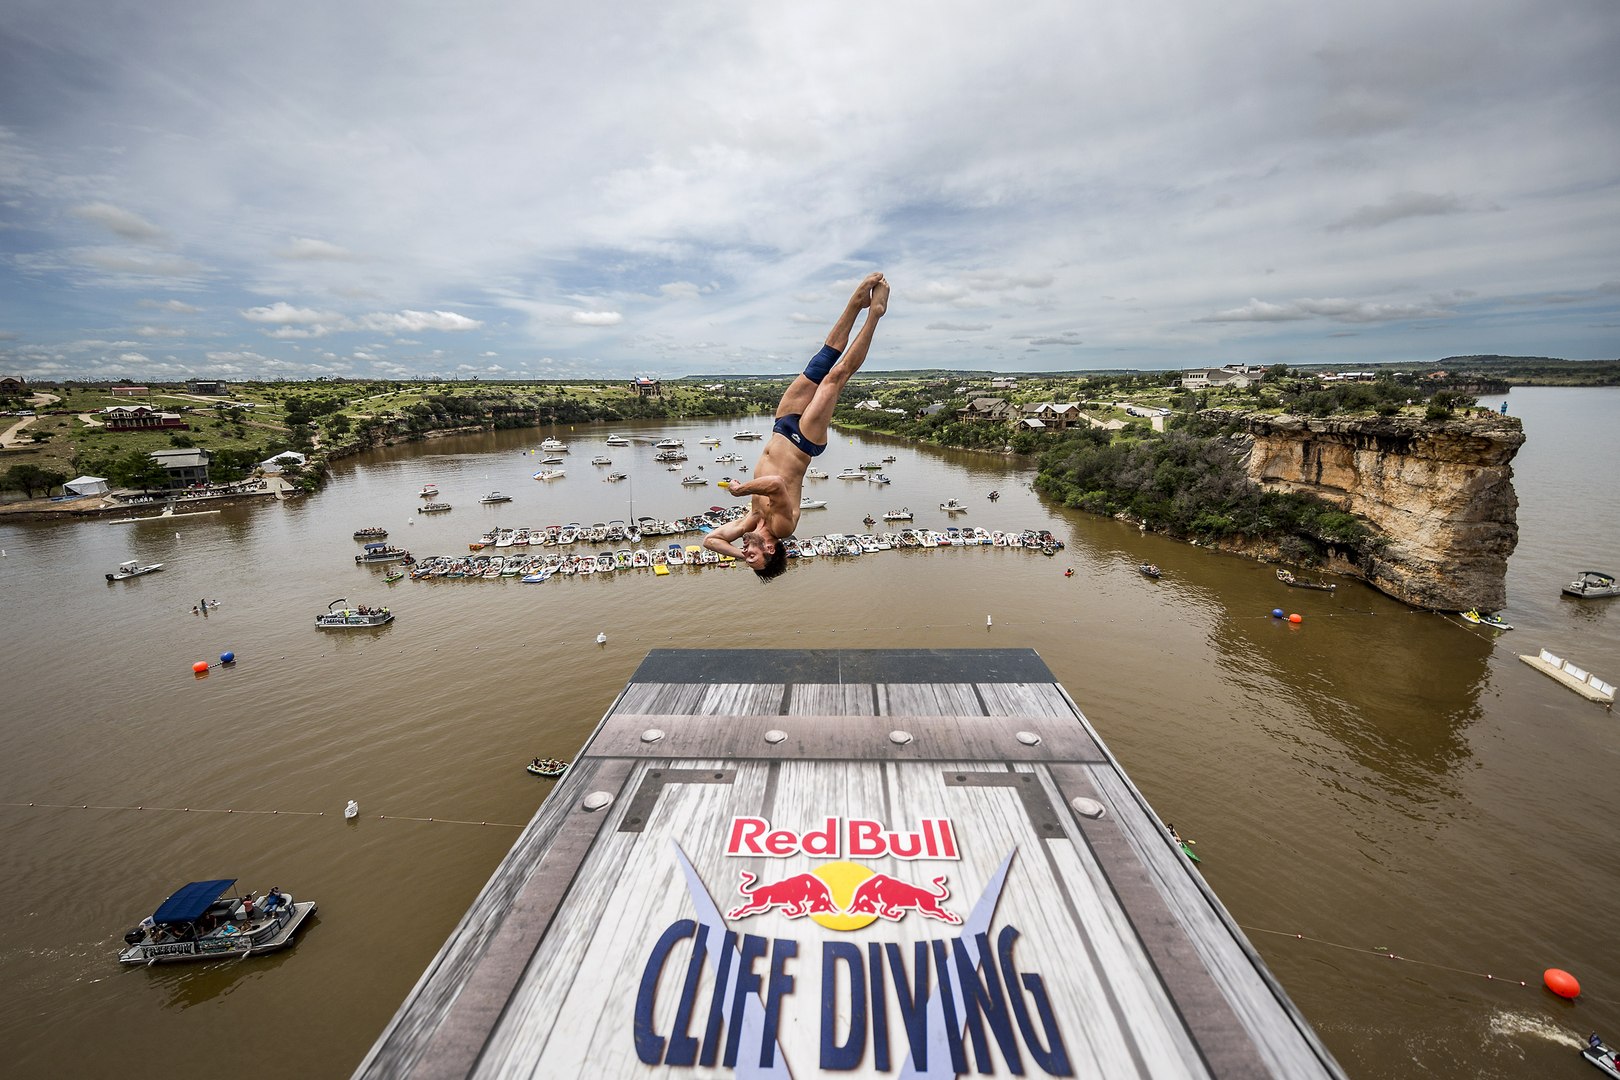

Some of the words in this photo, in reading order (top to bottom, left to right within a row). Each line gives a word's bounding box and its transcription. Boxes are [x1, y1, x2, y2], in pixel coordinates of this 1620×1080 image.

[728, 818, 838, 855] Red
[849, 820, 956, 857] Bull
[633, 919, 798, 1069] CLIFF
[819, 924, 1075, 1078] DIVING
